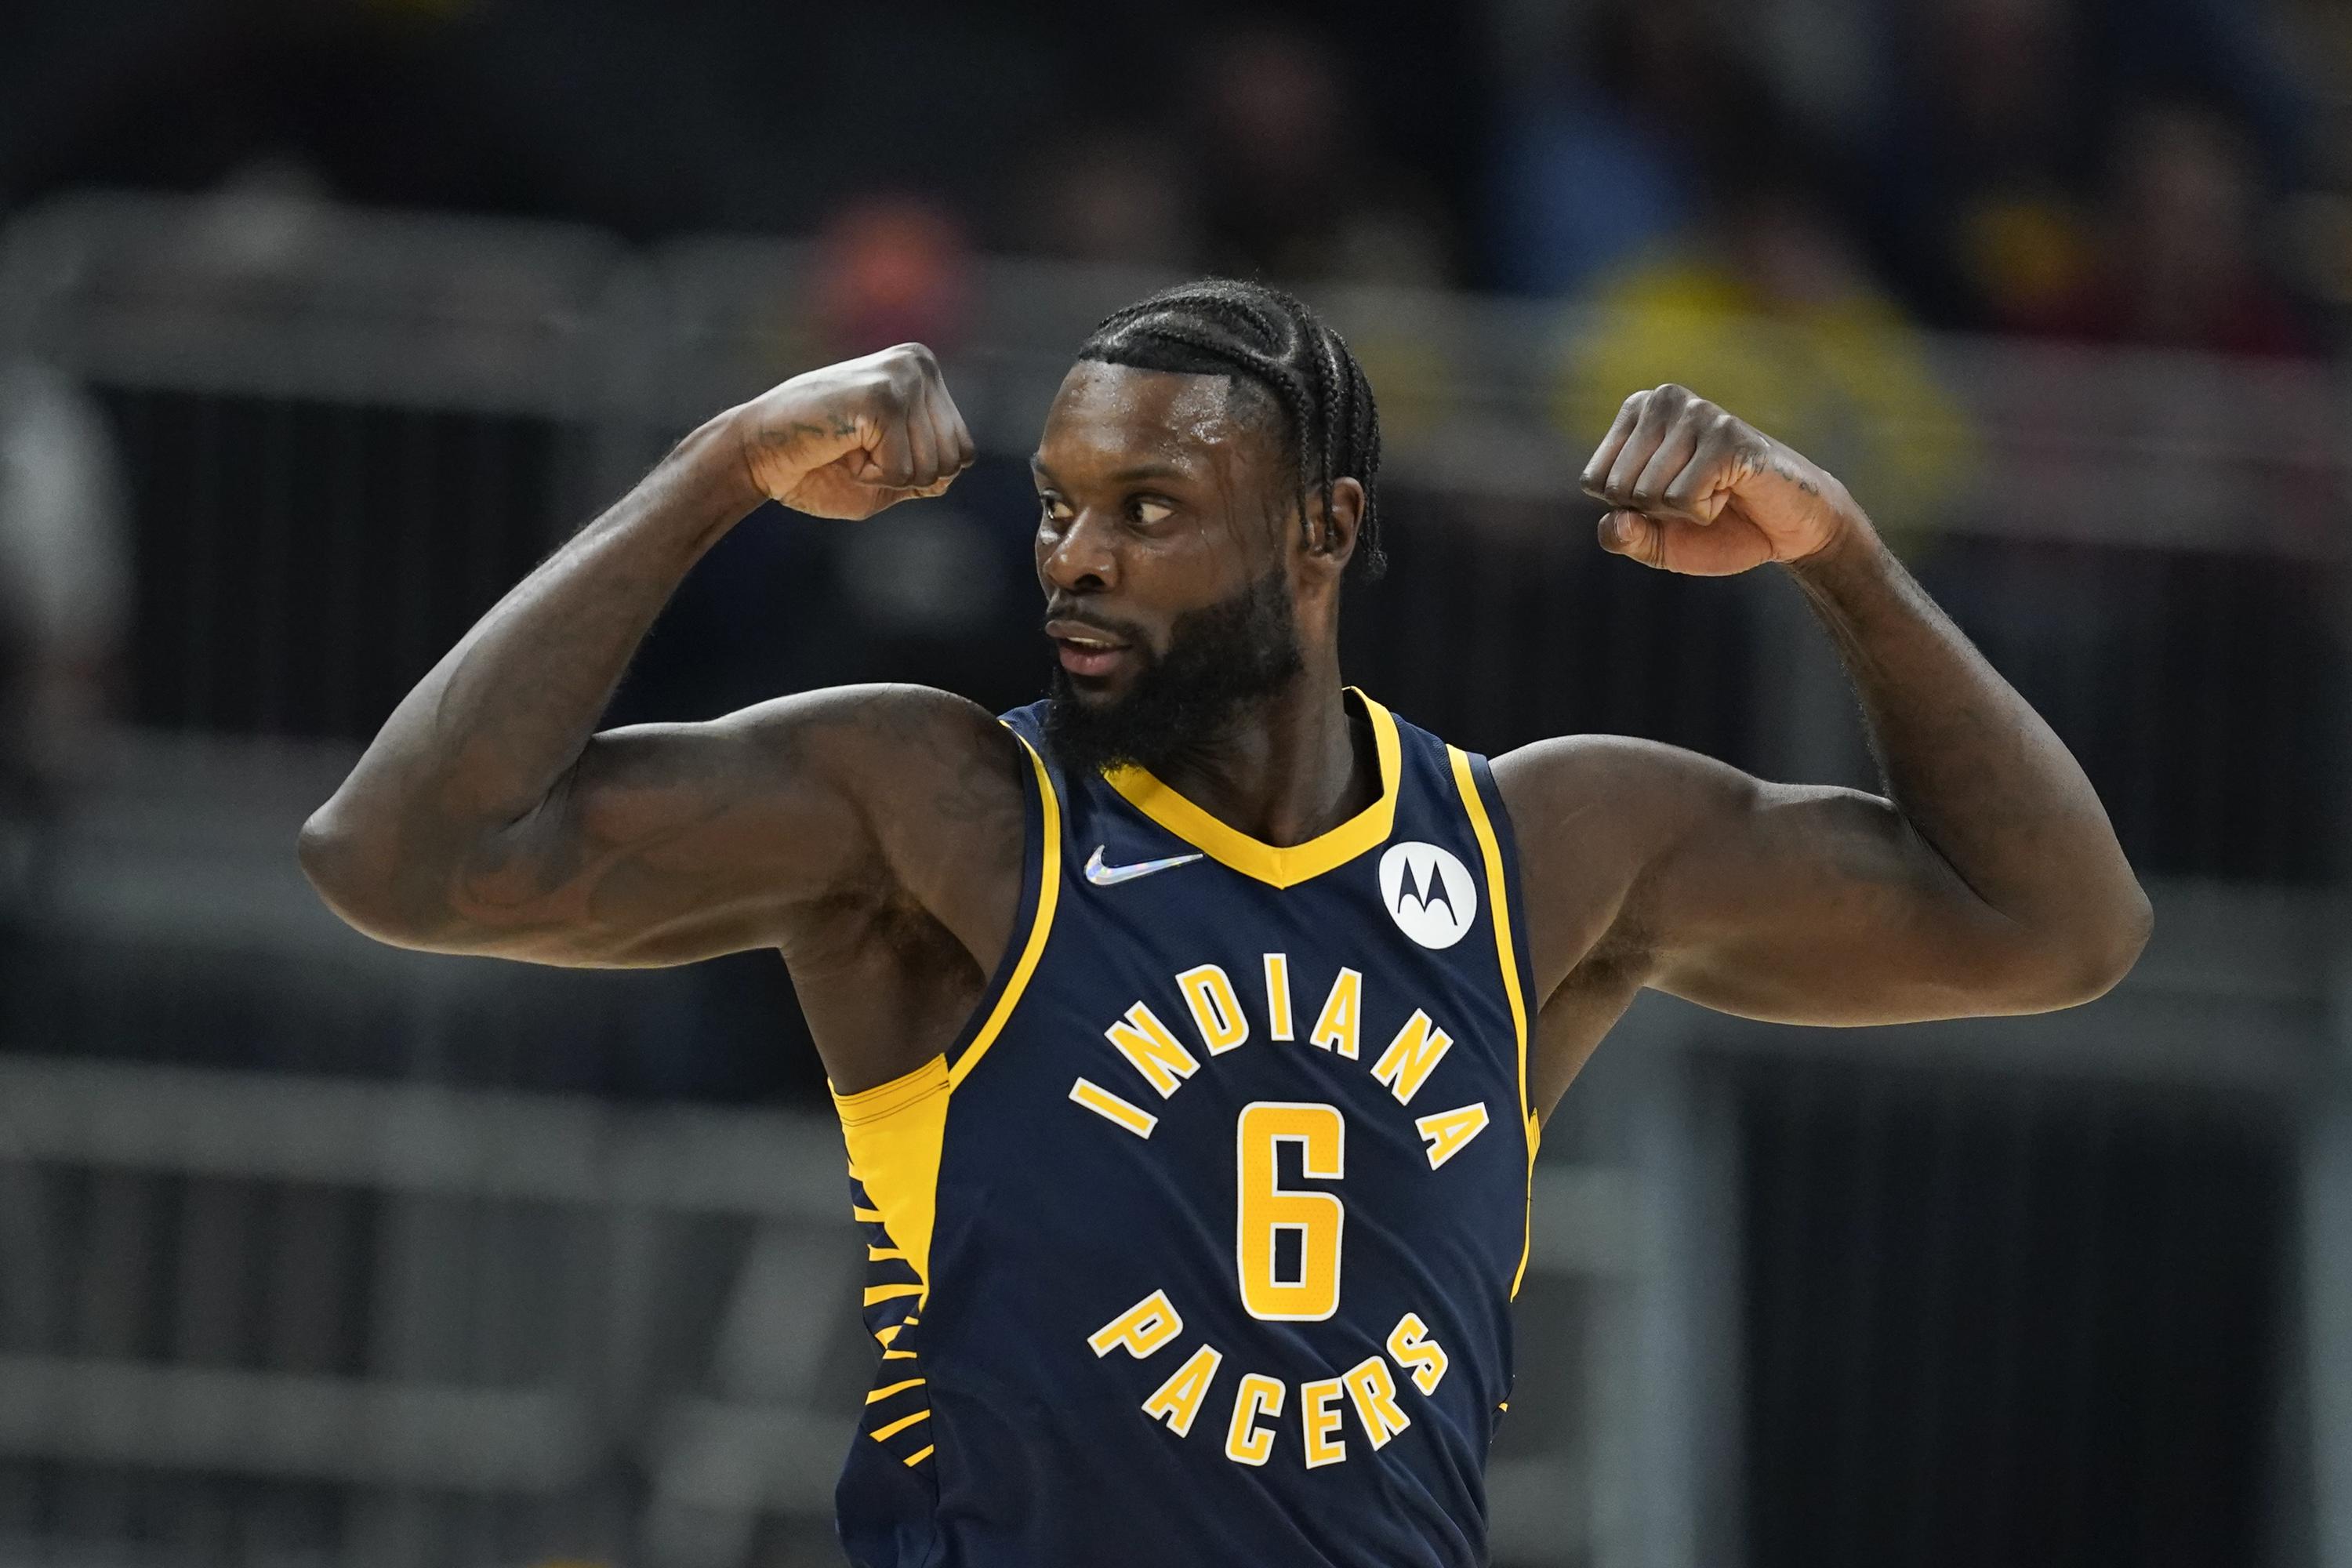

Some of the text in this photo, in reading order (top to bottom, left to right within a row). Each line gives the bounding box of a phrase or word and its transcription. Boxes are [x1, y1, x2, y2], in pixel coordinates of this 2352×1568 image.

[1069, 953, 1489, 1171] INDIANA
[1237, 1102, 1345, 1321] 6
[1087, 1289, 1448, 1469] PACERS
